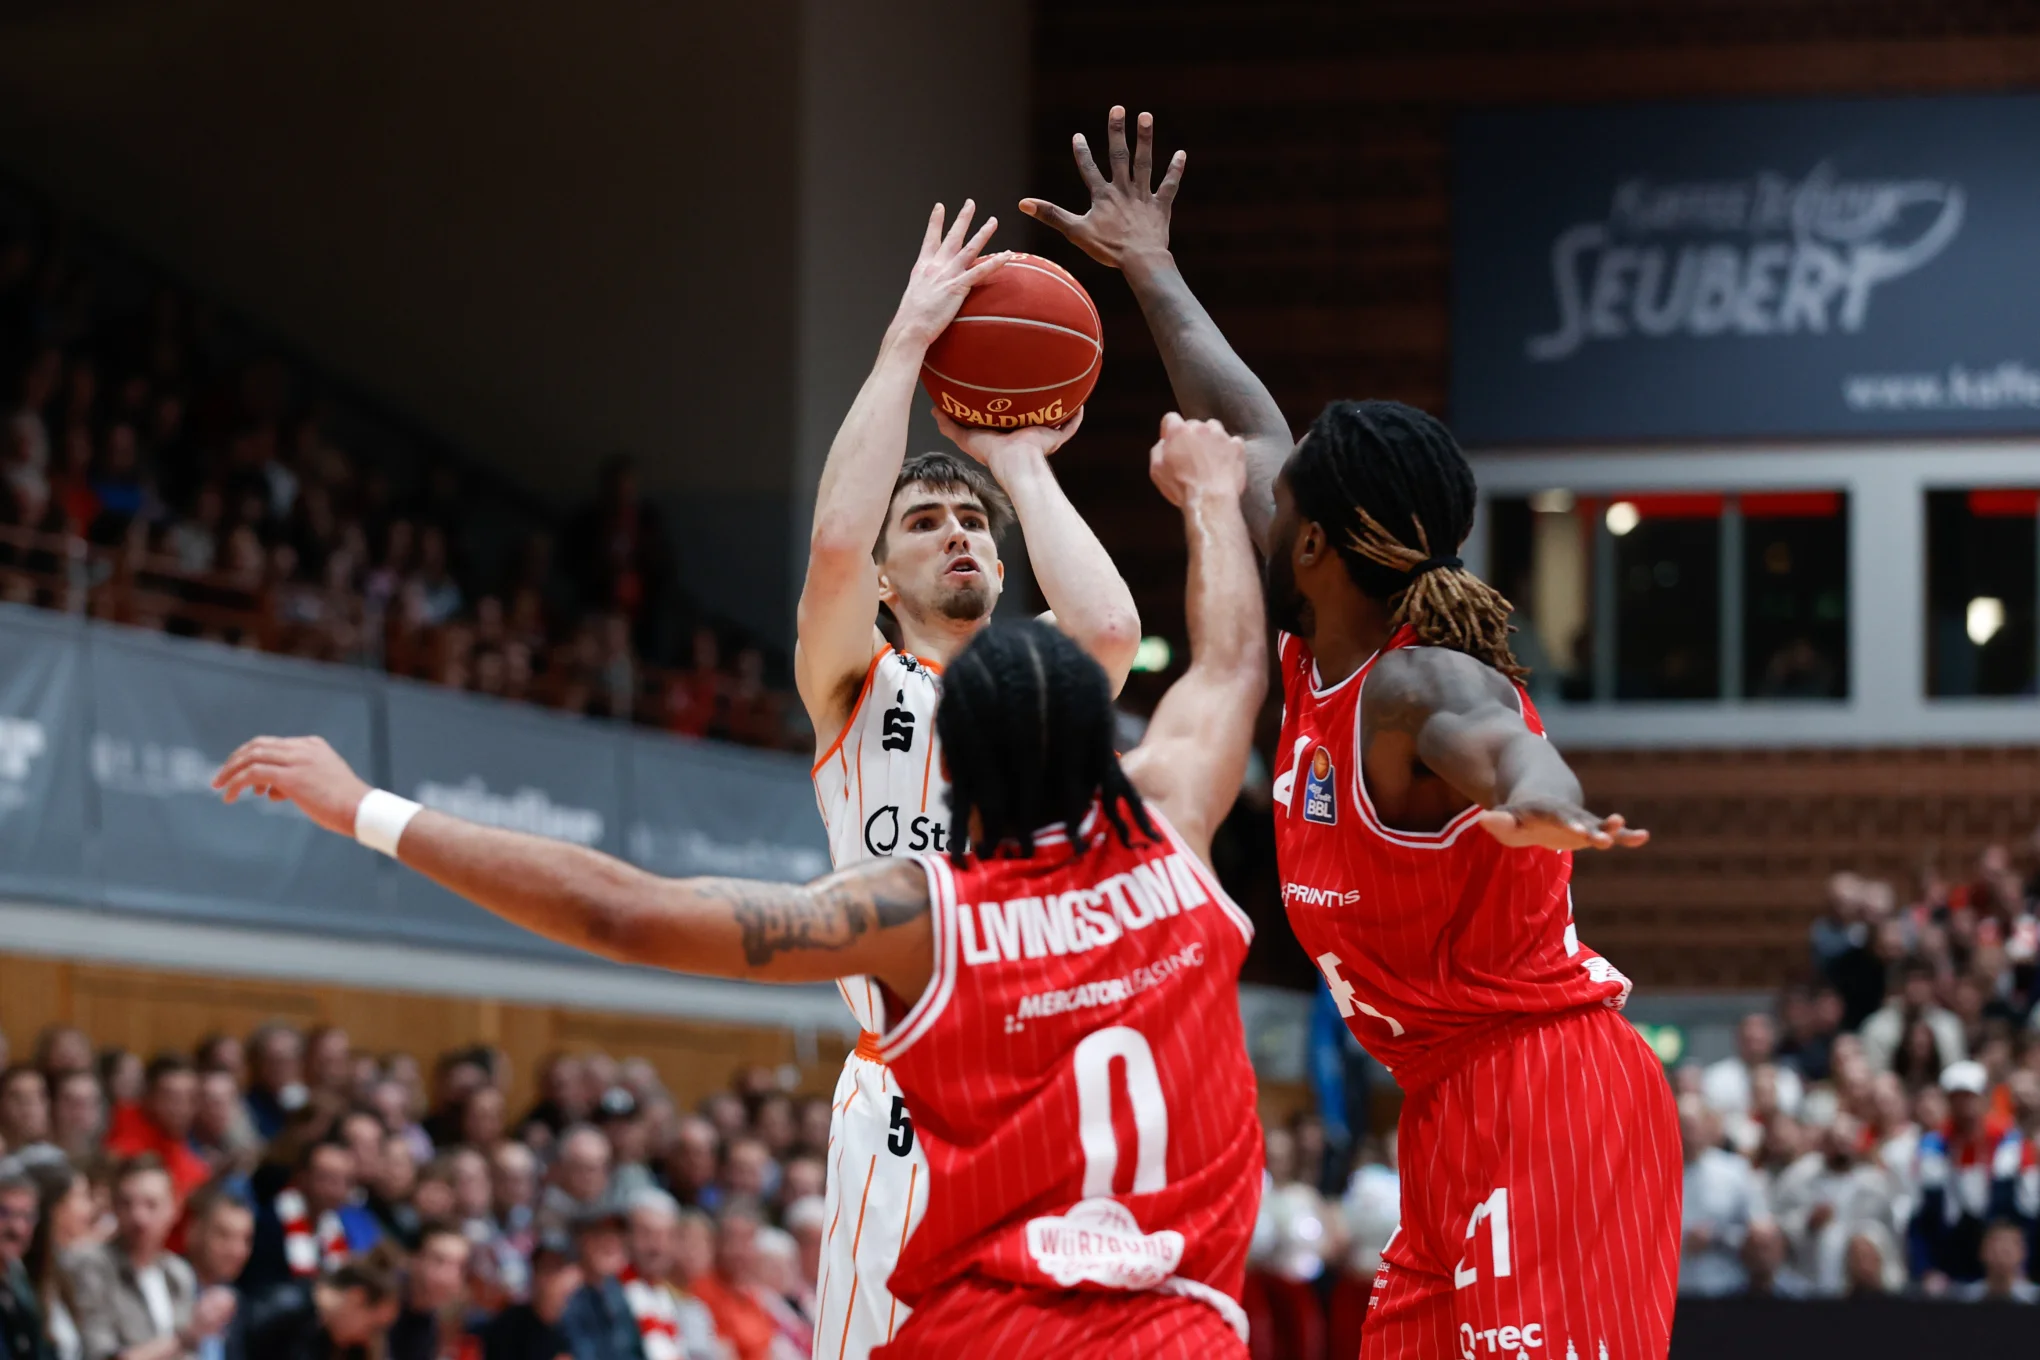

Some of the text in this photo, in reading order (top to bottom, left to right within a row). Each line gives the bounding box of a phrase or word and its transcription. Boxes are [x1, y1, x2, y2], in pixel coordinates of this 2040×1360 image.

[941, 391, 1063, 429] SPALDING
[1306, 799, 1332, 818] BBL
[887, 1095, 915, 1157] 5
